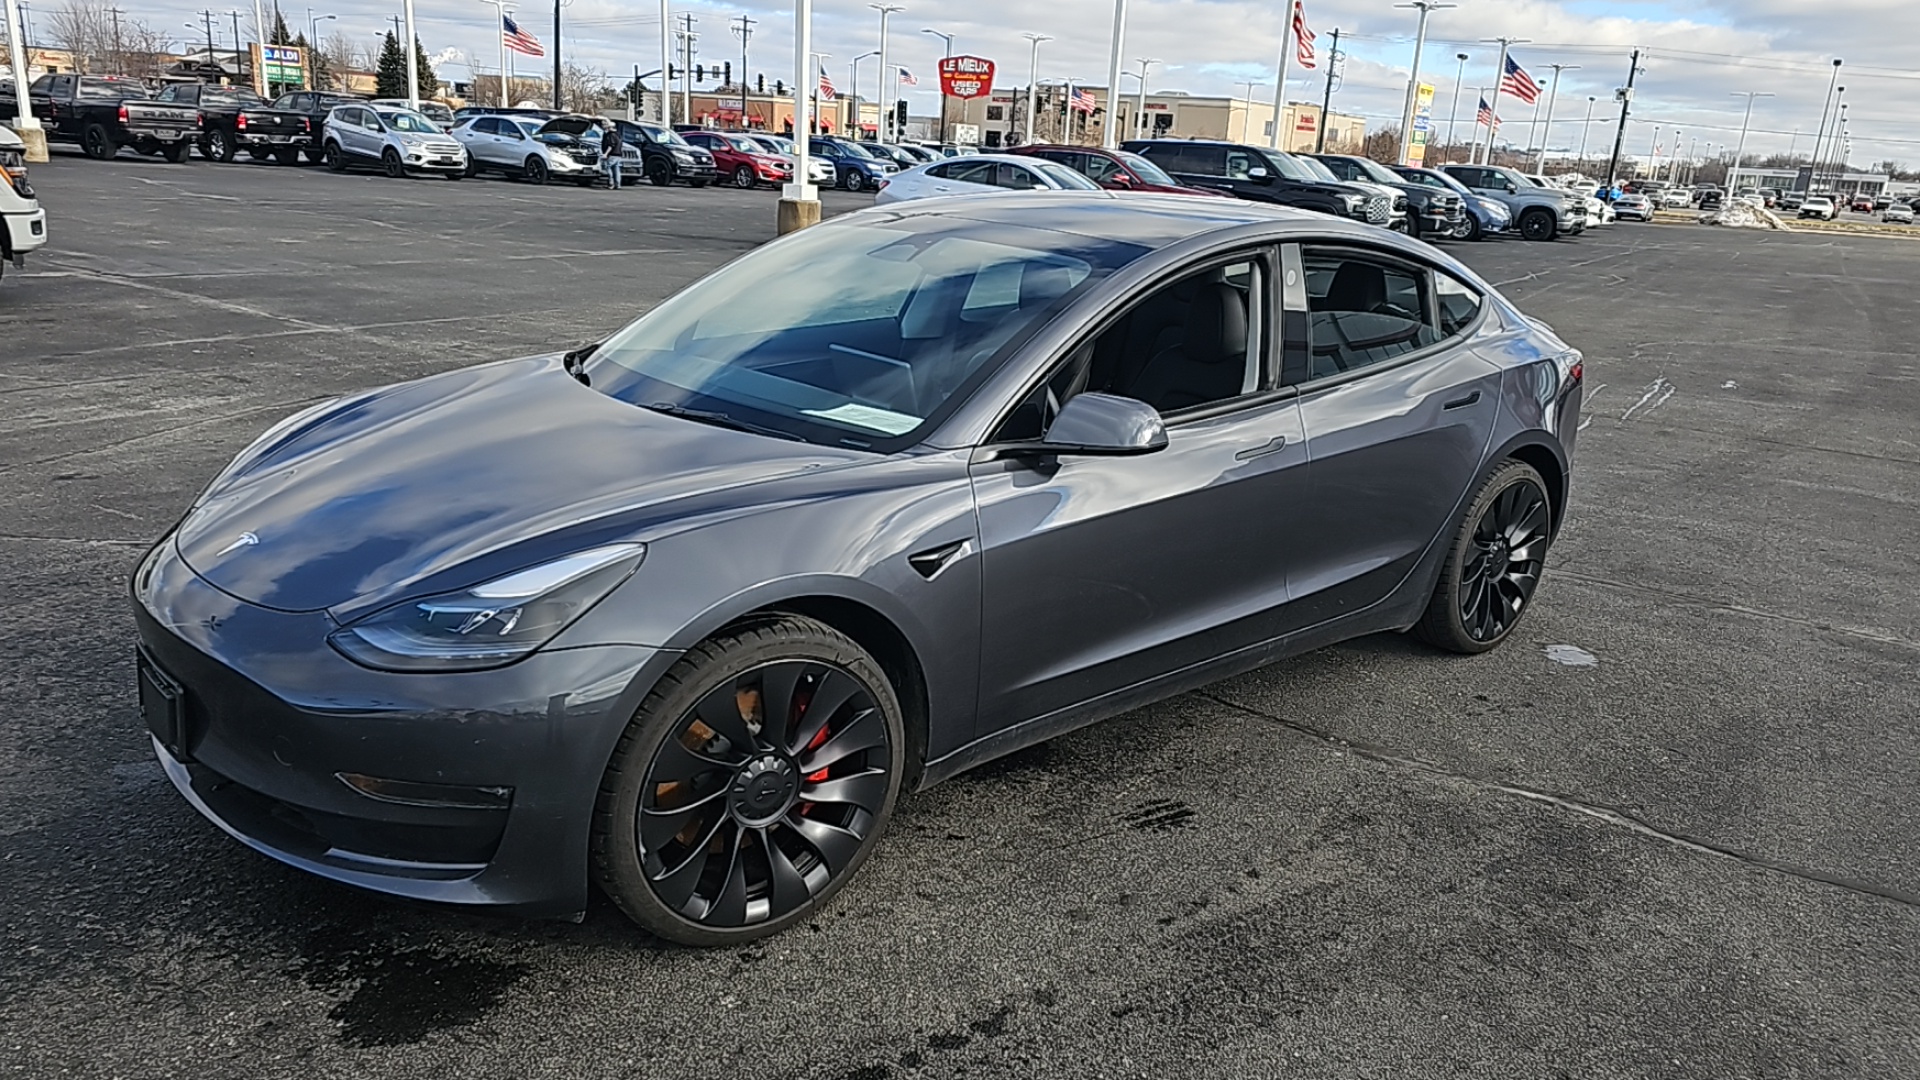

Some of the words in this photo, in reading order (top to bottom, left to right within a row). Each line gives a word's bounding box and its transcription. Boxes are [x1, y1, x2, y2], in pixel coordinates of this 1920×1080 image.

[273, 50, 299, 60] ALDI
[943, 60, 955, 70] LE
[958, 58, 989, 72] MIEUX
[951, 80, 981, 88] USED
[954, 87, 977, 95] CARS
[143, 109, 185, 118] RAM
